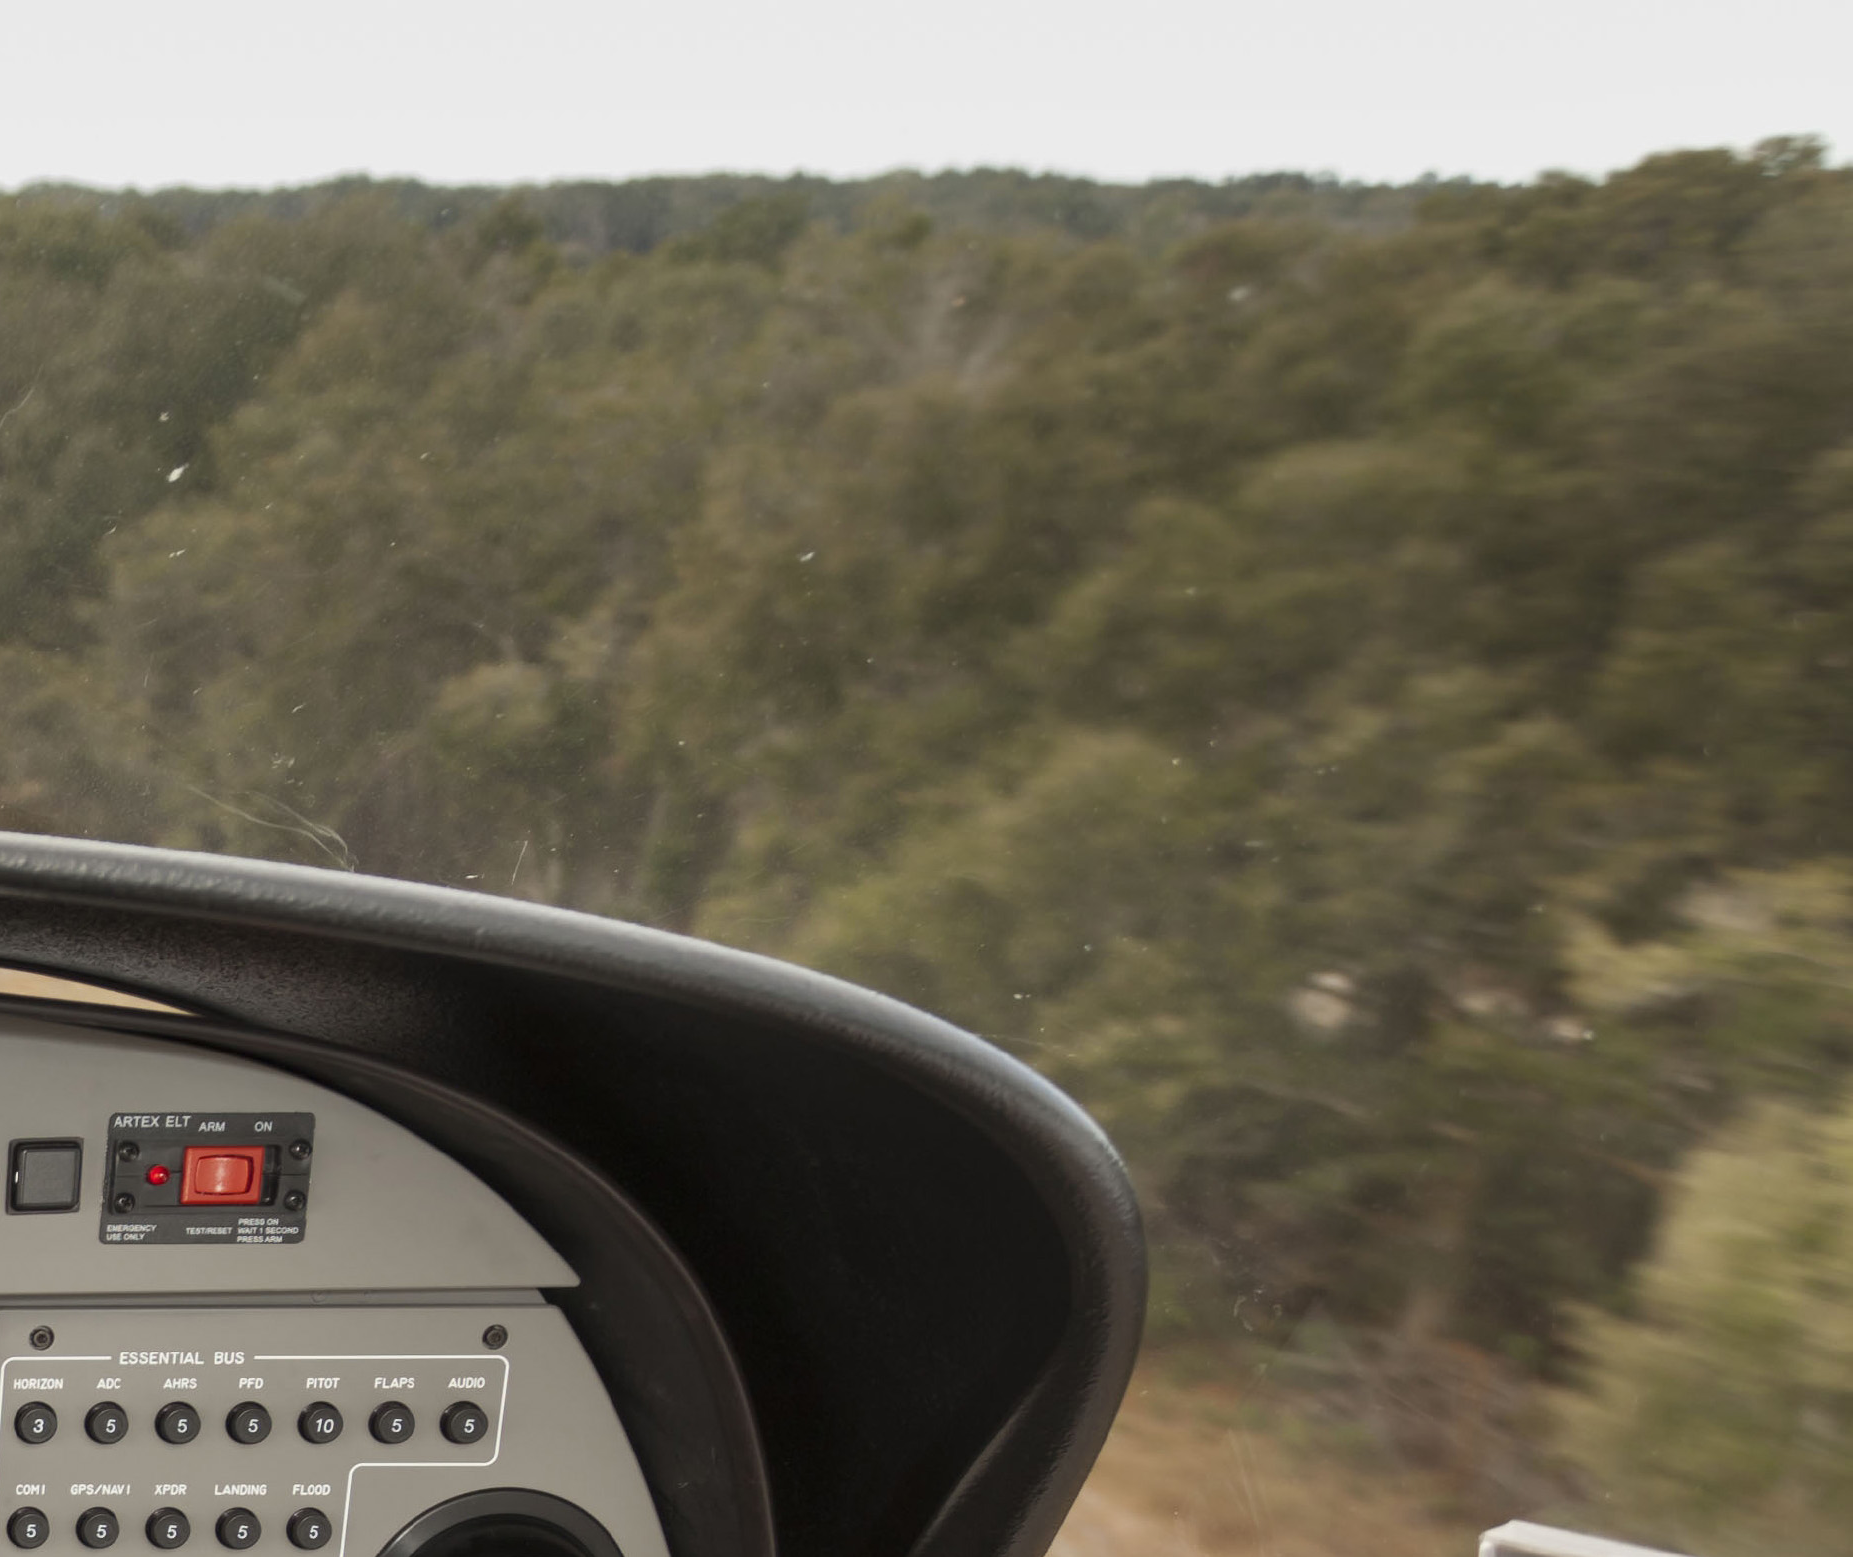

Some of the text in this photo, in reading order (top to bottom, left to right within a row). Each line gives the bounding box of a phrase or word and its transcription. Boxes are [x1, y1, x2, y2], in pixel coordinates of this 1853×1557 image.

[114, 1116, 191, 1127] ARTEX ELT
[199, 1122, 225, 1131] ARM
[255, 1121, 272, 1132] ON
[120, 1352, 244, 1364] ESSENTIAL BUS
[14, 1378, 63, 1389] HORIZON
[97, 1378, 121, 1389] ADC
[163, 1378, 197, 1389] AHRS
[239, 1378, 263, 1389] PFD
[307, 1378, 340, 1388] PITOT
[375, 1377, 414, 1388] FLAPS
[448, 1377, 485, 1388] AUDIO
